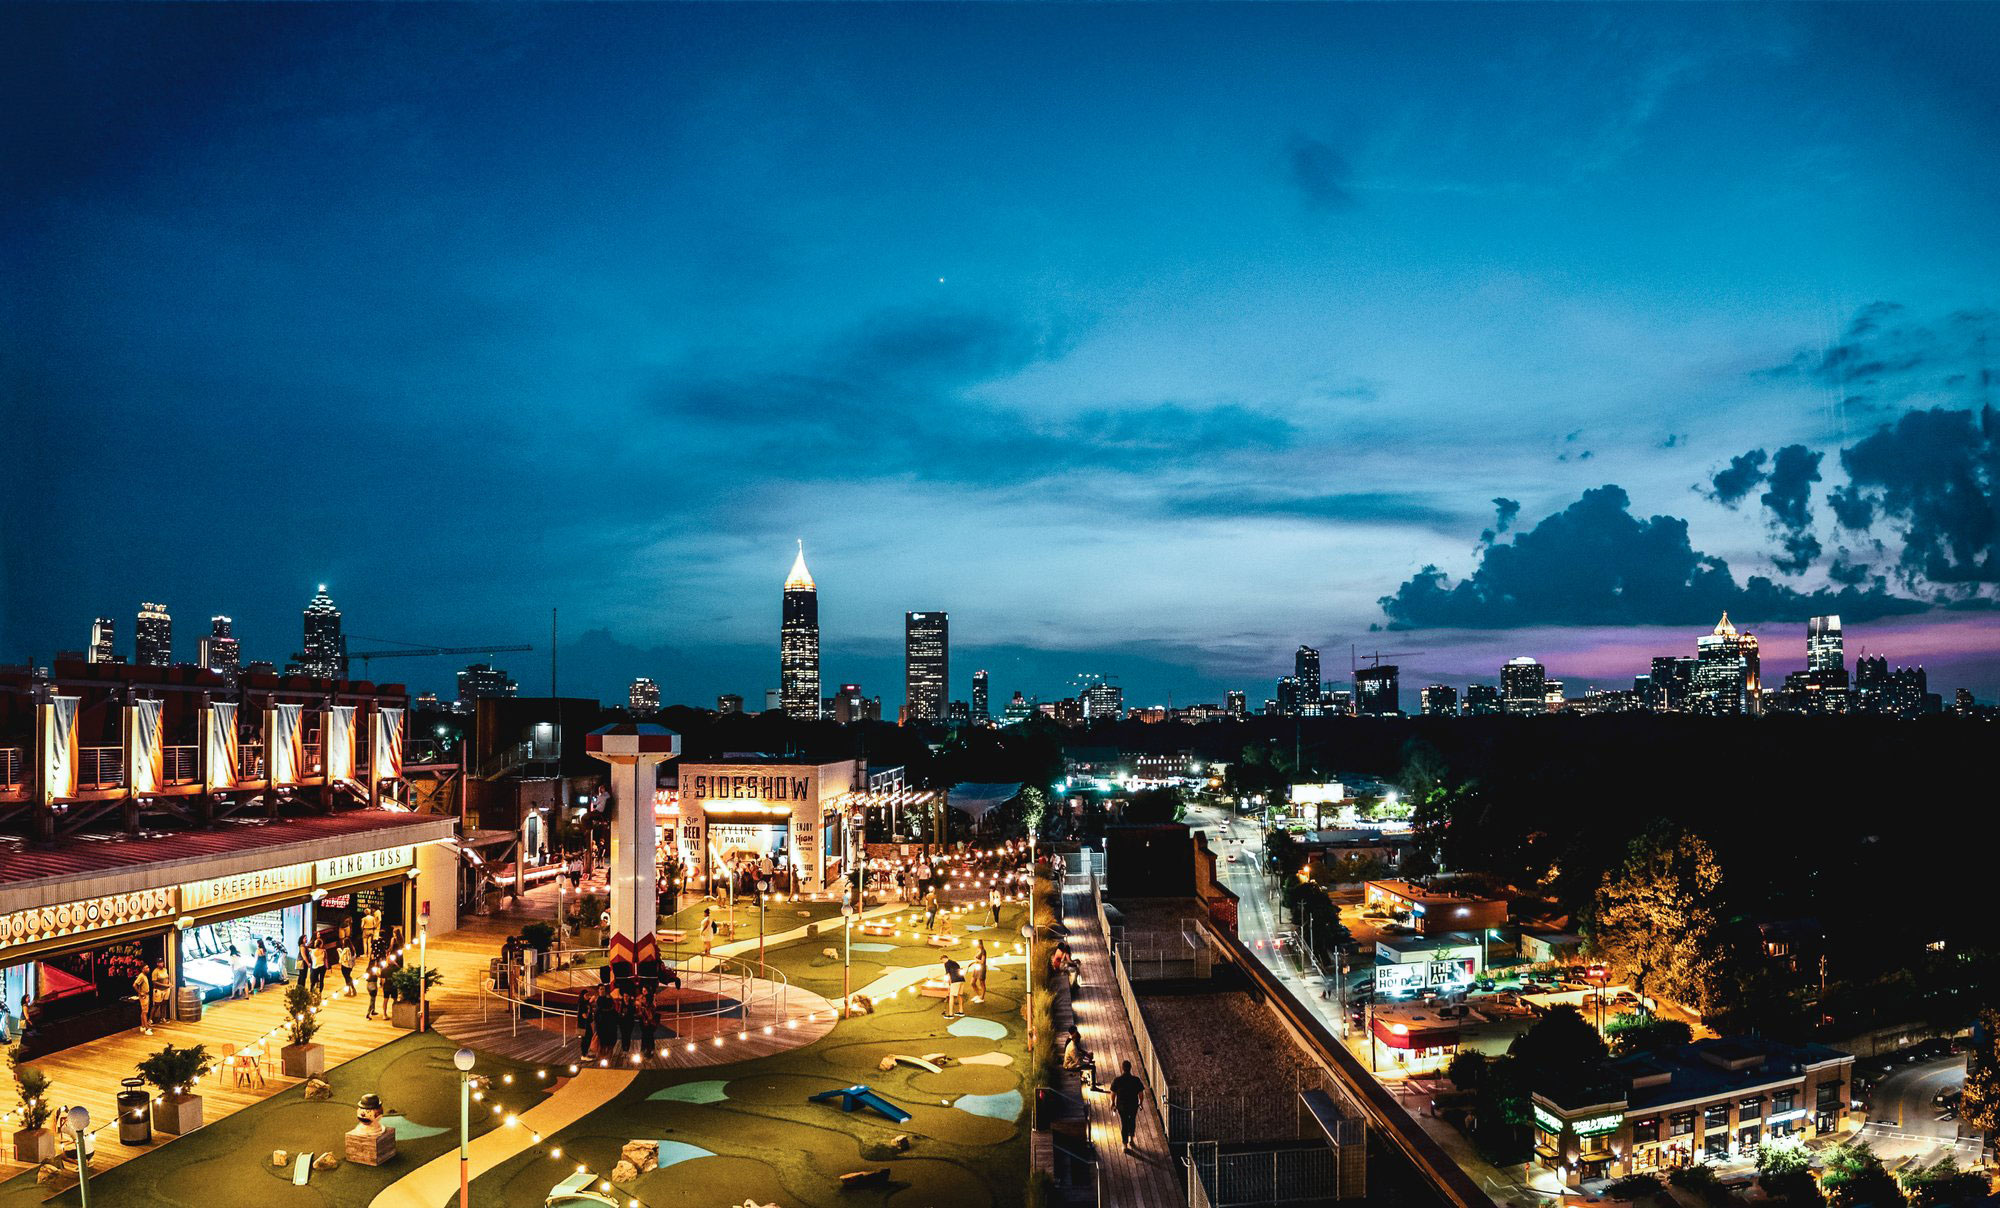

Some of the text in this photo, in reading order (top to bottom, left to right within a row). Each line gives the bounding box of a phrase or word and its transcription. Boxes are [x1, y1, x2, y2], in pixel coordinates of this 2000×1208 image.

[695, 775, 810, 800] SIDESHOW
[683, 826, 700, 839] BEER
[796, 822, 813, 832] ENJOY
[724, 836, 746, 844] PARK
[329, 849, 402, 877] RING TOSS
[213, 873, 286, 897] SKEE-BALL
[1431, 962, 1452, 974] THE
[1431, 973, 1450, 985] ATL
